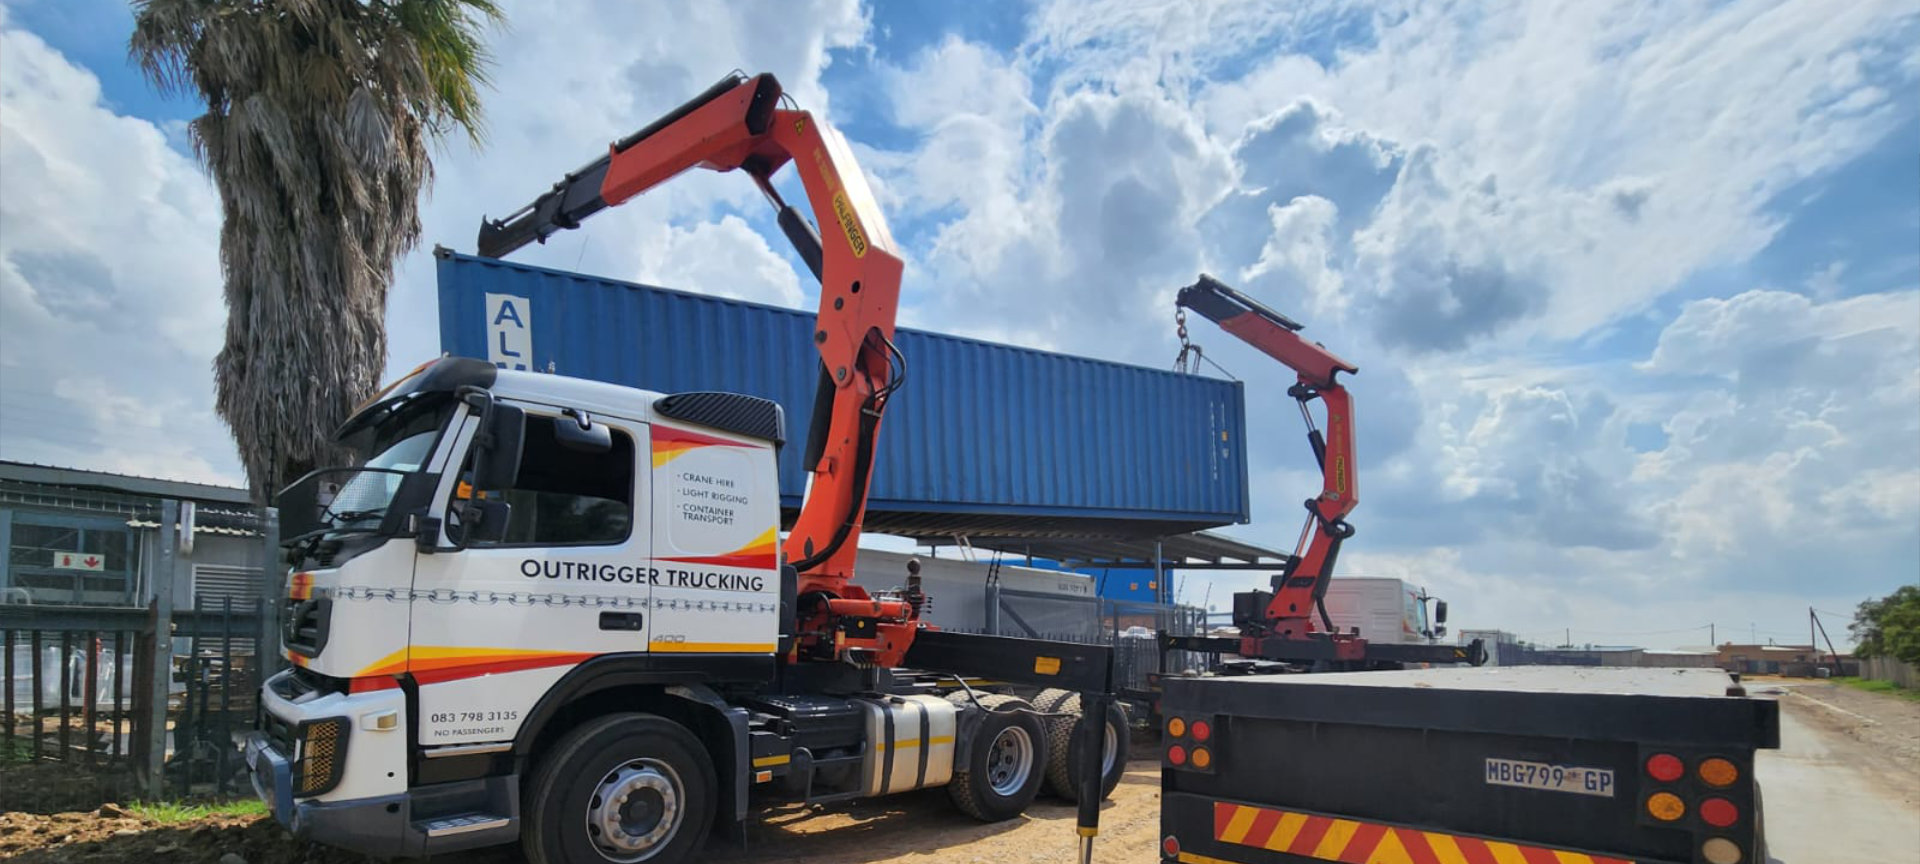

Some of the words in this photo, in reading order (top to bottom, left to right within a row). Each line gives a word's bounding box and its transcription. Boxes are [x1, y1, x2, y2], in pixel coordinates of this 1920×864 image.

[834, 194, 866, 255] PALFINGER
[683, 472, 713, 485] CRANE
[716, 478, 735, 488] HIRE
[682, 487, 709, 499] LIGHT
[711, 491, 749, 505] RIGGING
[682, 503, 735, 517] CONTAINER
[682, 511, 734, 526] TRANSPORT
[520, 559, 660, 585] OUTRIGGER
[666, 569, 764, 592] TRUCKING
[653, 634, 686, 644] 400
[431, 713, 456, 723] 083
[460, 712, 484, 722] 798
[487, 711, 518, 721] 3135
[434, 729, 450, 737] NO
[452, 727, 504, 736] PASSENGERS
[1487, 761, 1564, 787] MBG799
[1584, 770, 1612, 792] GP
